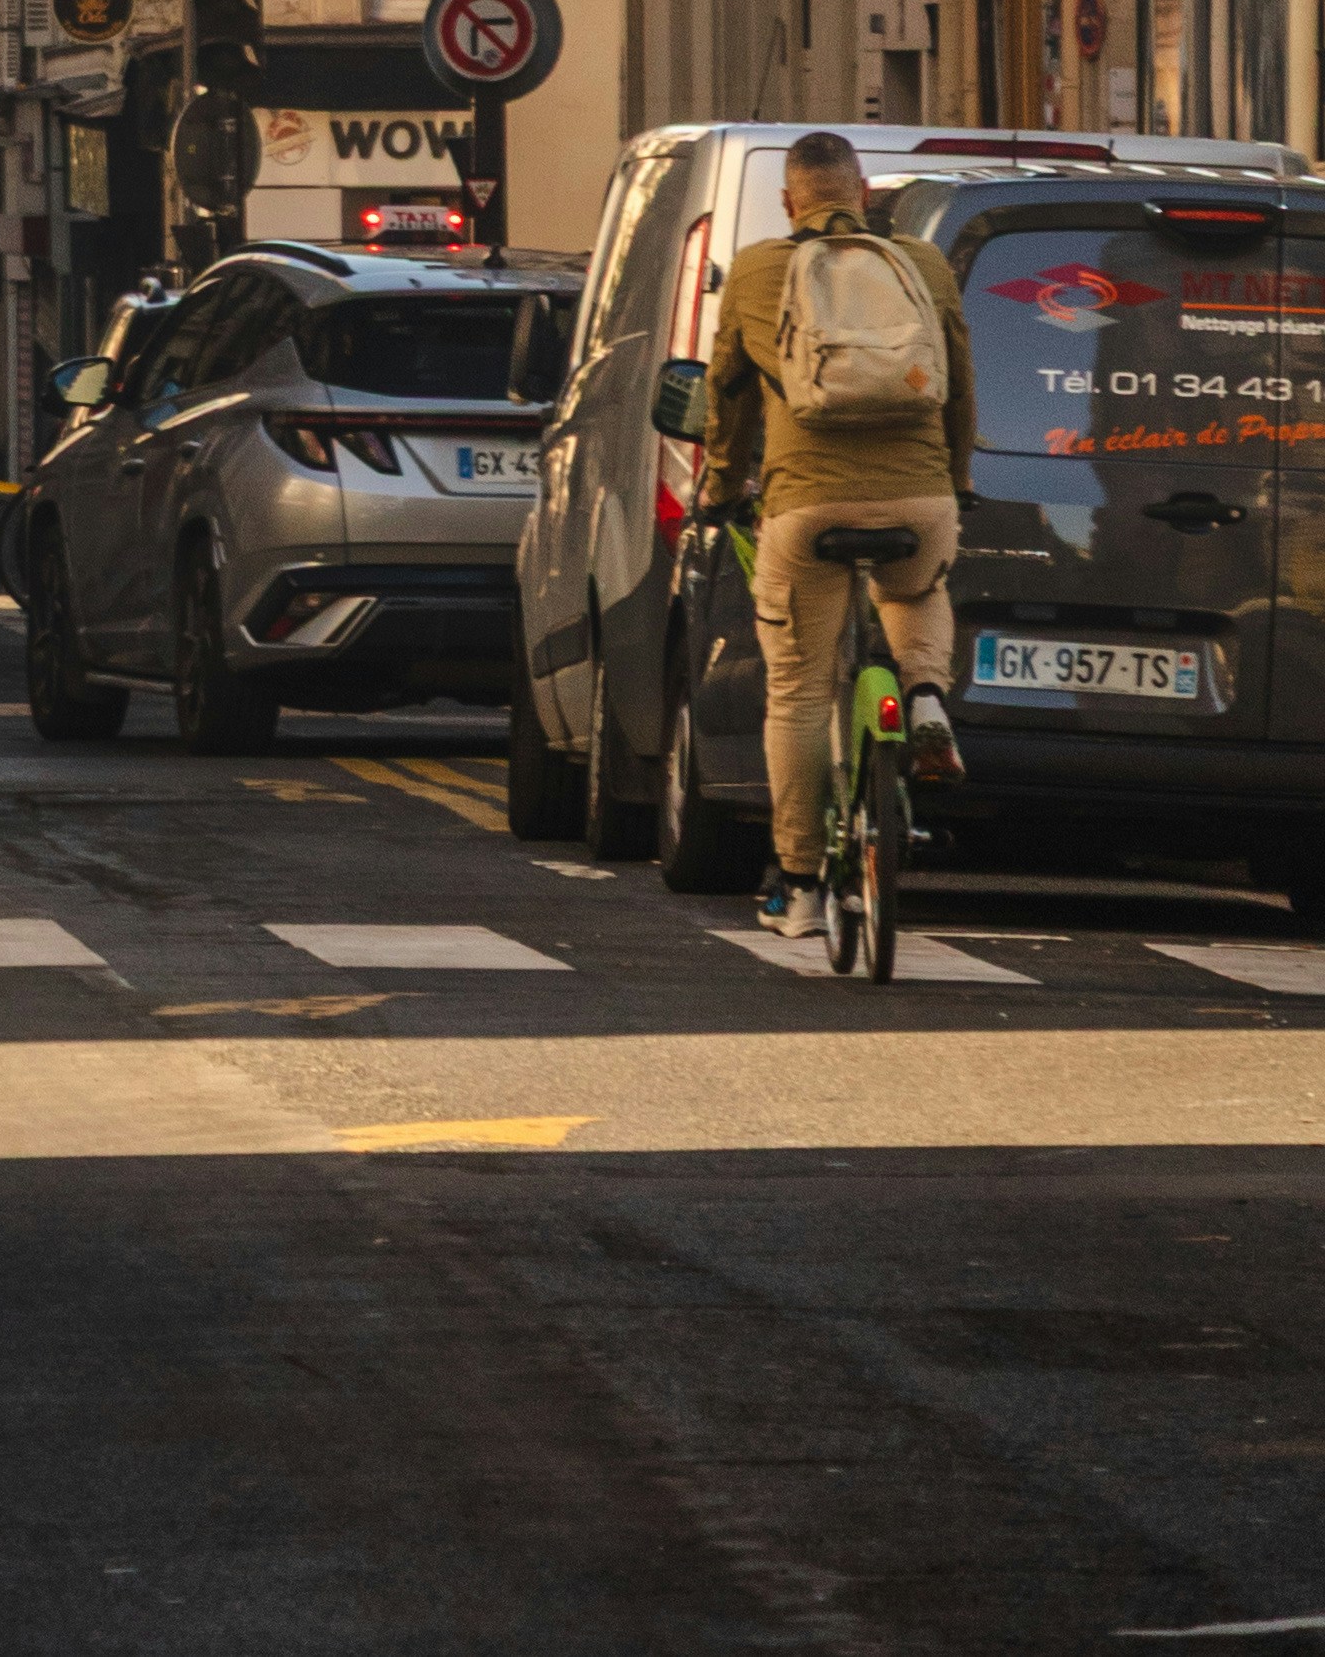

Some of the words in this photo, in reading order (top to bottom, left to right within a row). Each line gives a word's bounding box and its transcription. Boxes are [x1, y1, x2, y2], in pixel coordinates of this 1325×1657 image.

[395, 211, 438, 224] TAXI
[1180, 313, 1266, 337] Nettoyage
[1037, 369, 1100, 394] Tél.
[1110, 371, 1158, 396] 01
[1173, 374, 1229, 399] 34
[1237, 376, 1292, 402] 43
[1045, 427, 1095, 456] Un
[1105, 425, 1187, 452] éclair
[1197, 421, 1230, 445] de
[999, 643, 1170, 689] GK-957-TS
